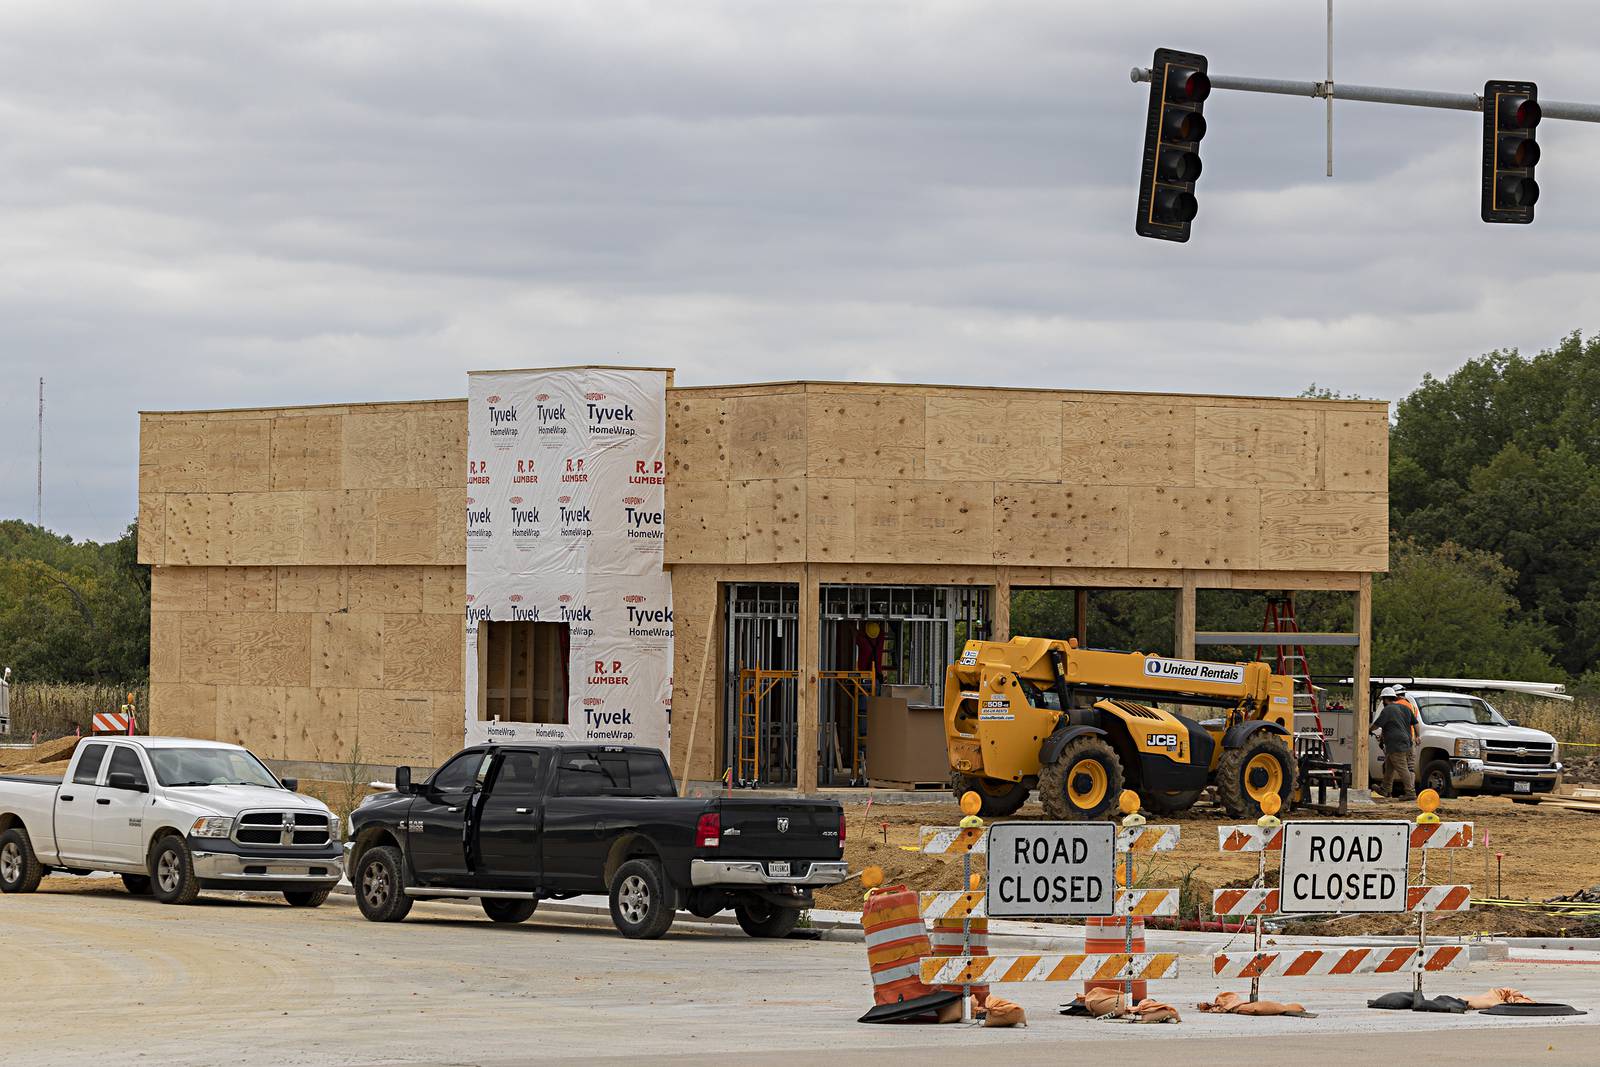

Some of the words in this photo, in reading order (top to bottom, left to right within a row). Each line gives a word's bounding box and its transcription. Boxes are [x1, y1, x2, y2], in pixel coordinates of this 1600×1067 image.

[489, 405, 517, 426] Tyvek
[537, 403, 565, 424] Tyvek
[587, 404, 633, 424] Tyvek
[490, 428, 518, 437] HomeWrap
[538, 426, 566, 435] HomeWrap
[589, 425, 635, 436] HomeWrap
[636, 460, 649, 474] R.
[654, 461, 663, 474] P.
[513, 475, 538, 483] LUMBER
[562, 474, 588, 482] LUMBER
[512, 506, 539, 527] Tyvek
[560, 506, 590, 526] Tyvek
[512, 528, 540, 538] HomeWrap
[561, 528, 592, 538] HomeWrap
[511, 605, 539, 620] Tyvek
[560, 605, 591, 621] Tyvek
[627, 606, 673, 626] Tyvek
[630, 627, 674, 638] HomeWrap
[595, 661, 607, 674] R.
[613, 661, 622, 673] P.
[1163, 662, 1198, 676] United
[1200, 666, 1239, 680] Rentals
[588, 677, 629, 685] LUMBER
[584, 708, 631, 729] Tyvek
[488, 727, 515, 737] HomeWrap
[536, 728, 564, 739] HomeWrap
[587, 730, 633, 740] HomeWrap
[1147, 735, 1177, 745] JCB
[1015, 837, 1088, 864] ROAD
[1310, 836, 1383, 862] ROAD
[999, 876, 1103, 903] CLOSED
[1293, 873, 1396, 900] CLOSED
